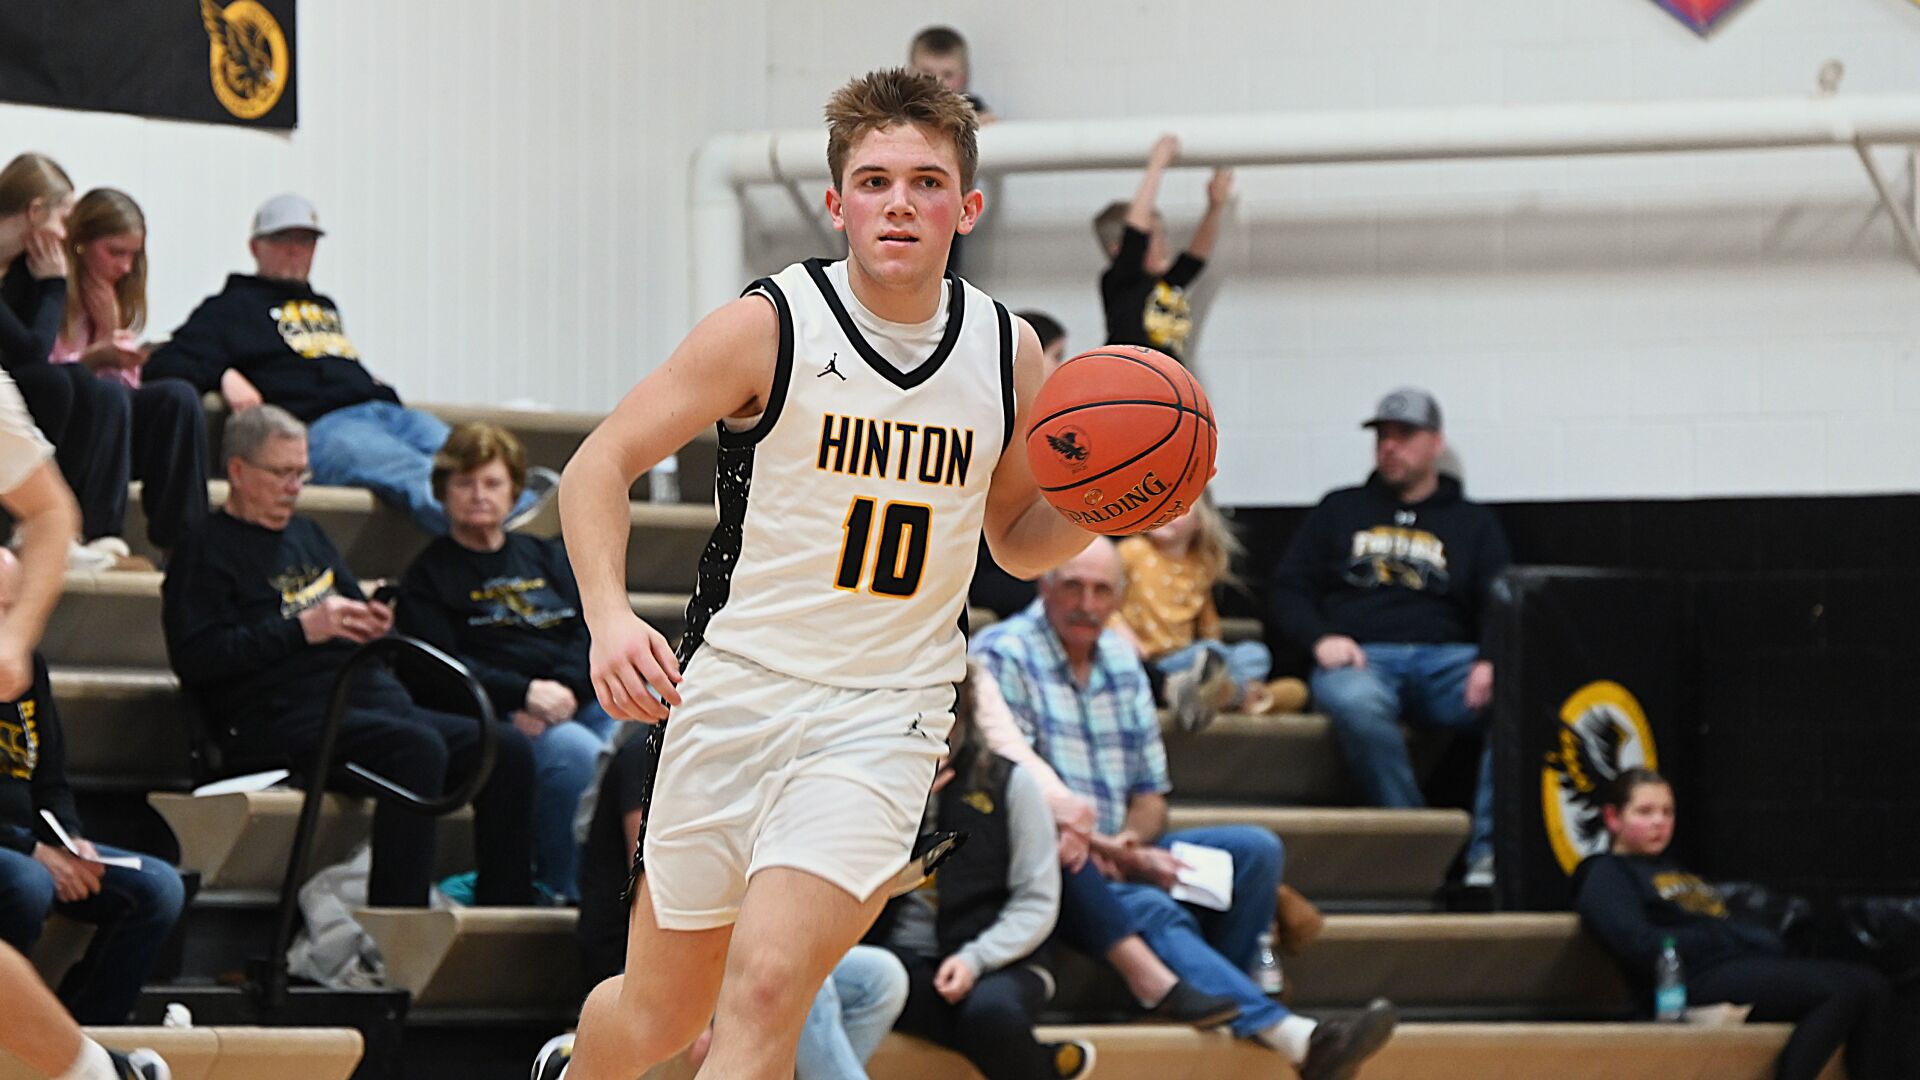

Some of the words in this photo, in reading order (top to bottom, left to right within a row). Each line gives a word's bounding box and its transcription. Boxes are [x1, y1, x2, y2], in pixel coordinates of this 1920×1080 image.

[816, 413, 974, 488] HINTON
[1056, 471, 1168, 524] PALDING
[833, 495, 934, 600] 10
